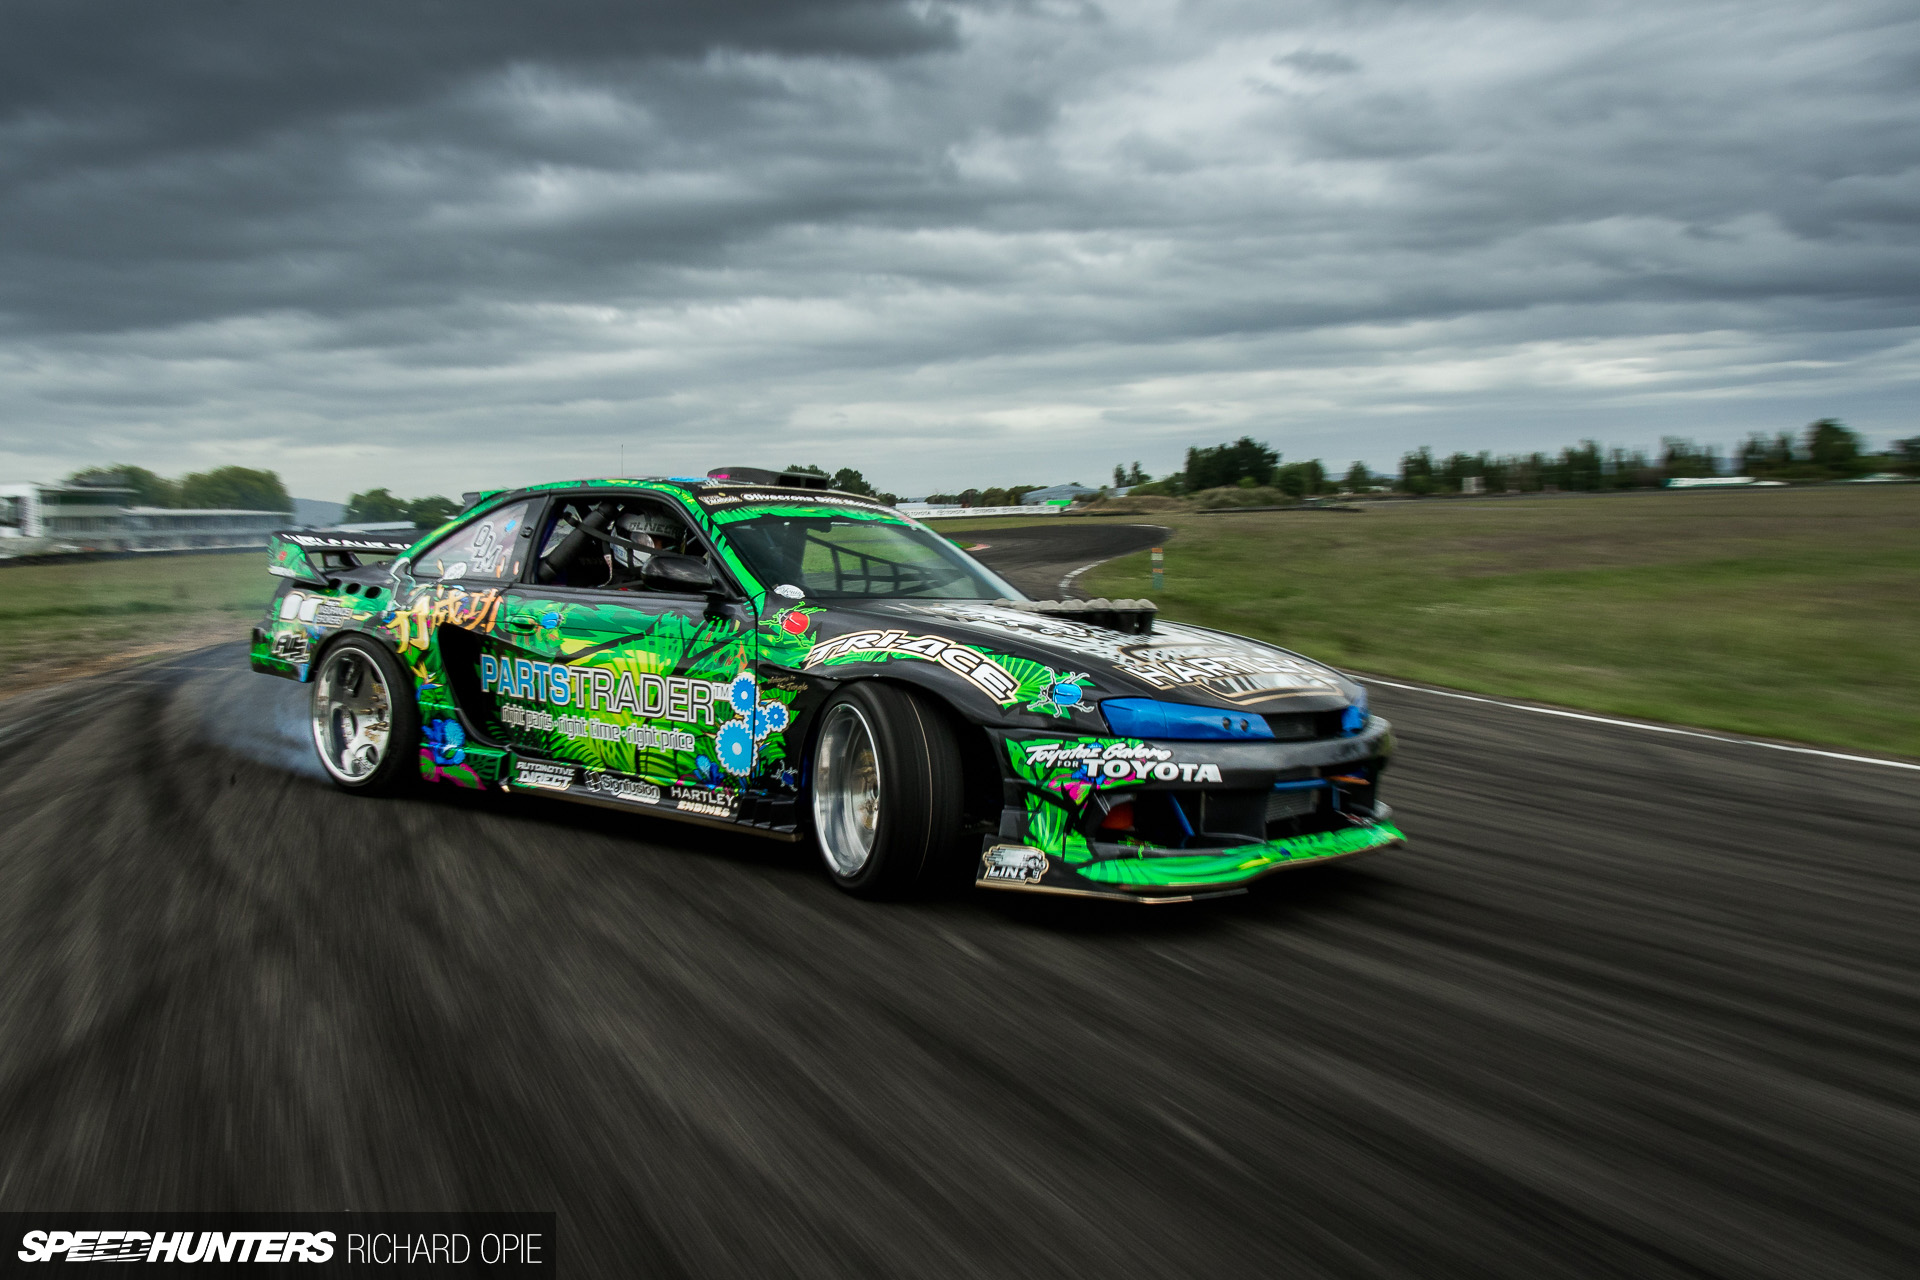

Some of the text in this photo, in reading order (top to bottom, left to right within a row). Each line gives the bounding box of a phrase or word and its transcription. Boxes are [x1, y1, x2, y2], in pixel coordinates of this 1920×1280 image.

[809, 631, 1016, 701] TRI-ACE
[1122, 655, 1312, 687] HARTLEY
[480, 654, 715, 726] PARTSTRADER
[660, 728, 695, 752] price
[515, 761, 576, 776] AUTOMOTIVE
[518, 770, 573, 788] DIRECT
[1057, 758, 1223, 783] FOR TOYOTA
